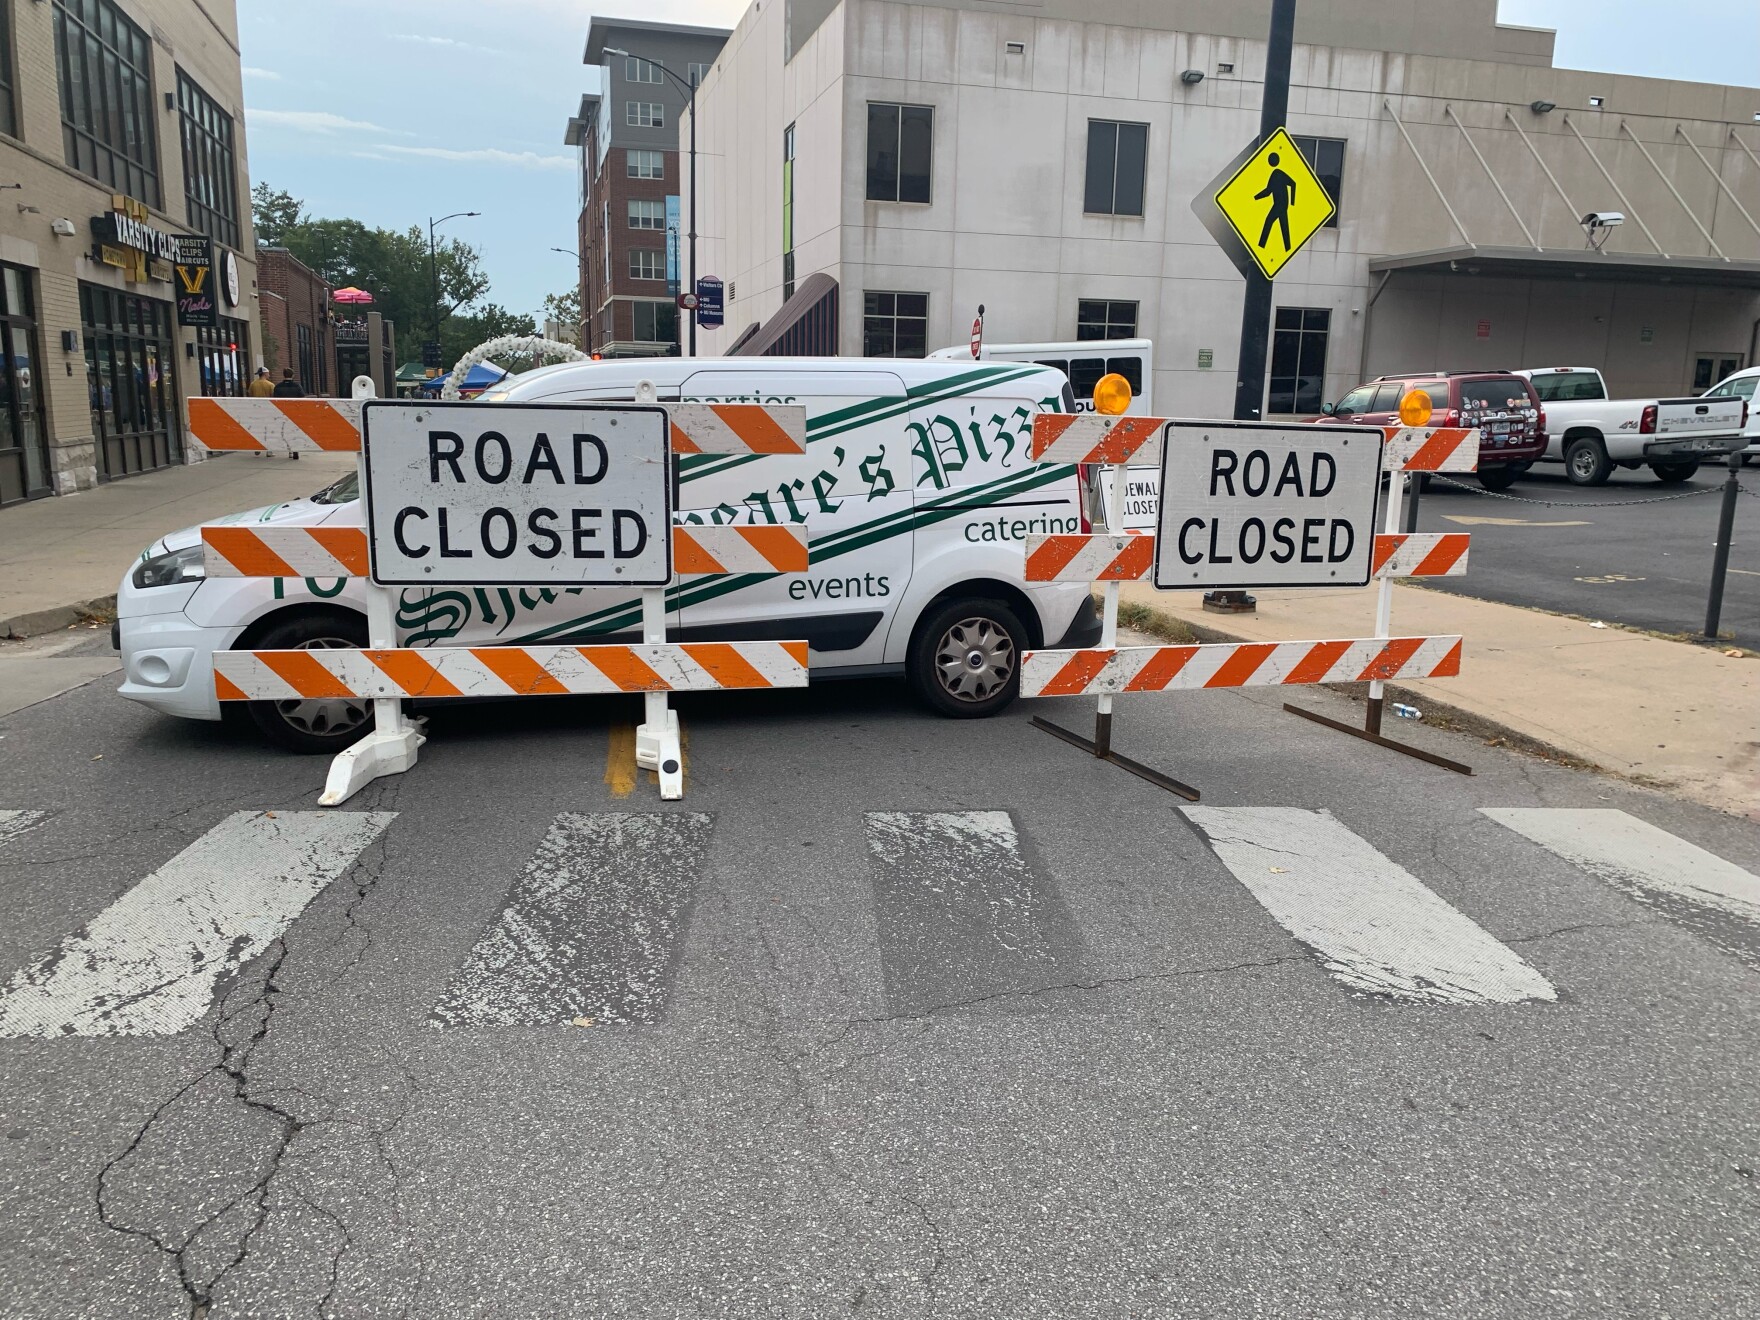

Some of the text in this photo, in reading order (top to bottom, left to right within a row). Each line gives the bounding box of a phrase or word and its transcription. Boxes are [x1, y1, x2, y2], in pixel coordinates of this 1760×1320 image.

[114, 211, 181, 263] VARSITY CLIPS
[179, 239, 207, 248] ARSITY
[181, 248, 203, 256] CLIPS
[181, 257, 209, 265] AIRCUTS
[179, 296, 212, 313] Nails
[1662, 414, 1738, 425] CHEVROLET
[429, 430, 609, 485] ROAD
[1209, 449, 1337, 498] ROAD
[1124, 500, 1158, 515] LOSE
[393, 506, 648, 559] CLOSED
[964, 512, 1078, 542] catering
[1178, 517, 1355, 564] CLOSED
[788, 572, 890, 600] events
